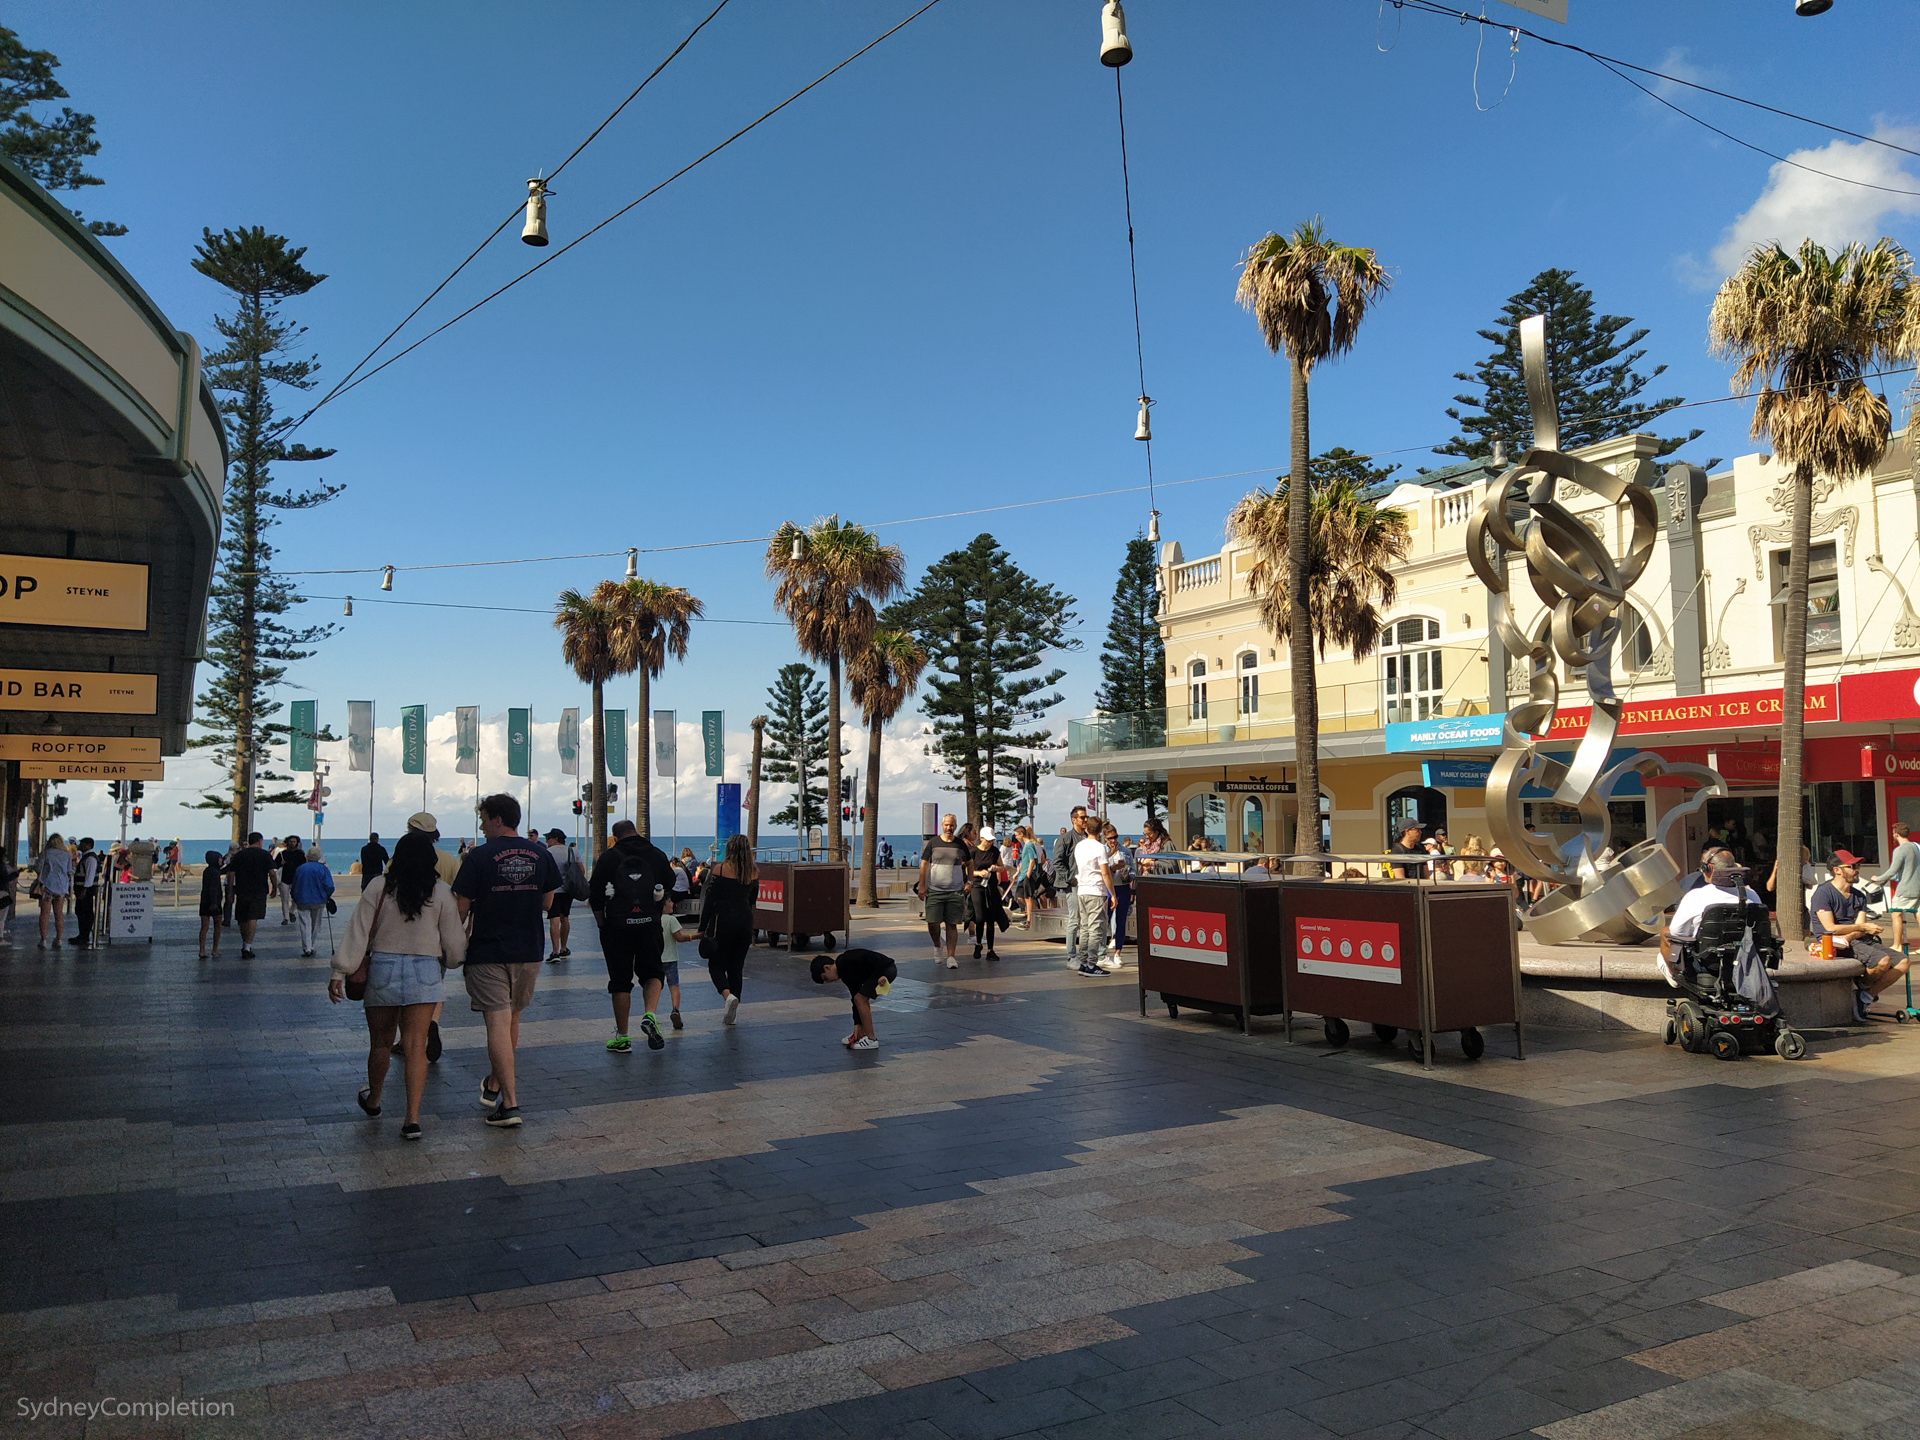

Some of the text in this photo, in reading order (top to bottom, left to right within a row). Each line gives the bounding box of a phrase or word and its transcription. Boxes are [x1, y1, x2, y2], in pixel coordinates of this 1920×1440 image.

[66, 586, 110, 597] STEYNE
[34, 682, 83, 698] BAR
[1551, 715, 1589, 730] OYAL
[1620, 704, 1713, 724] PENHAGEN
[1719, 701, 1751, 717] ICE
[1410, 732, 1438, 743] MANLY
[1438, 730, 1468, 740] OCEAN
[1470, 727, 1501, 738] FOODS
[32, 742, 107, 754] ROOFTOP
[59, 765, 127, 774] BEACH BAR
